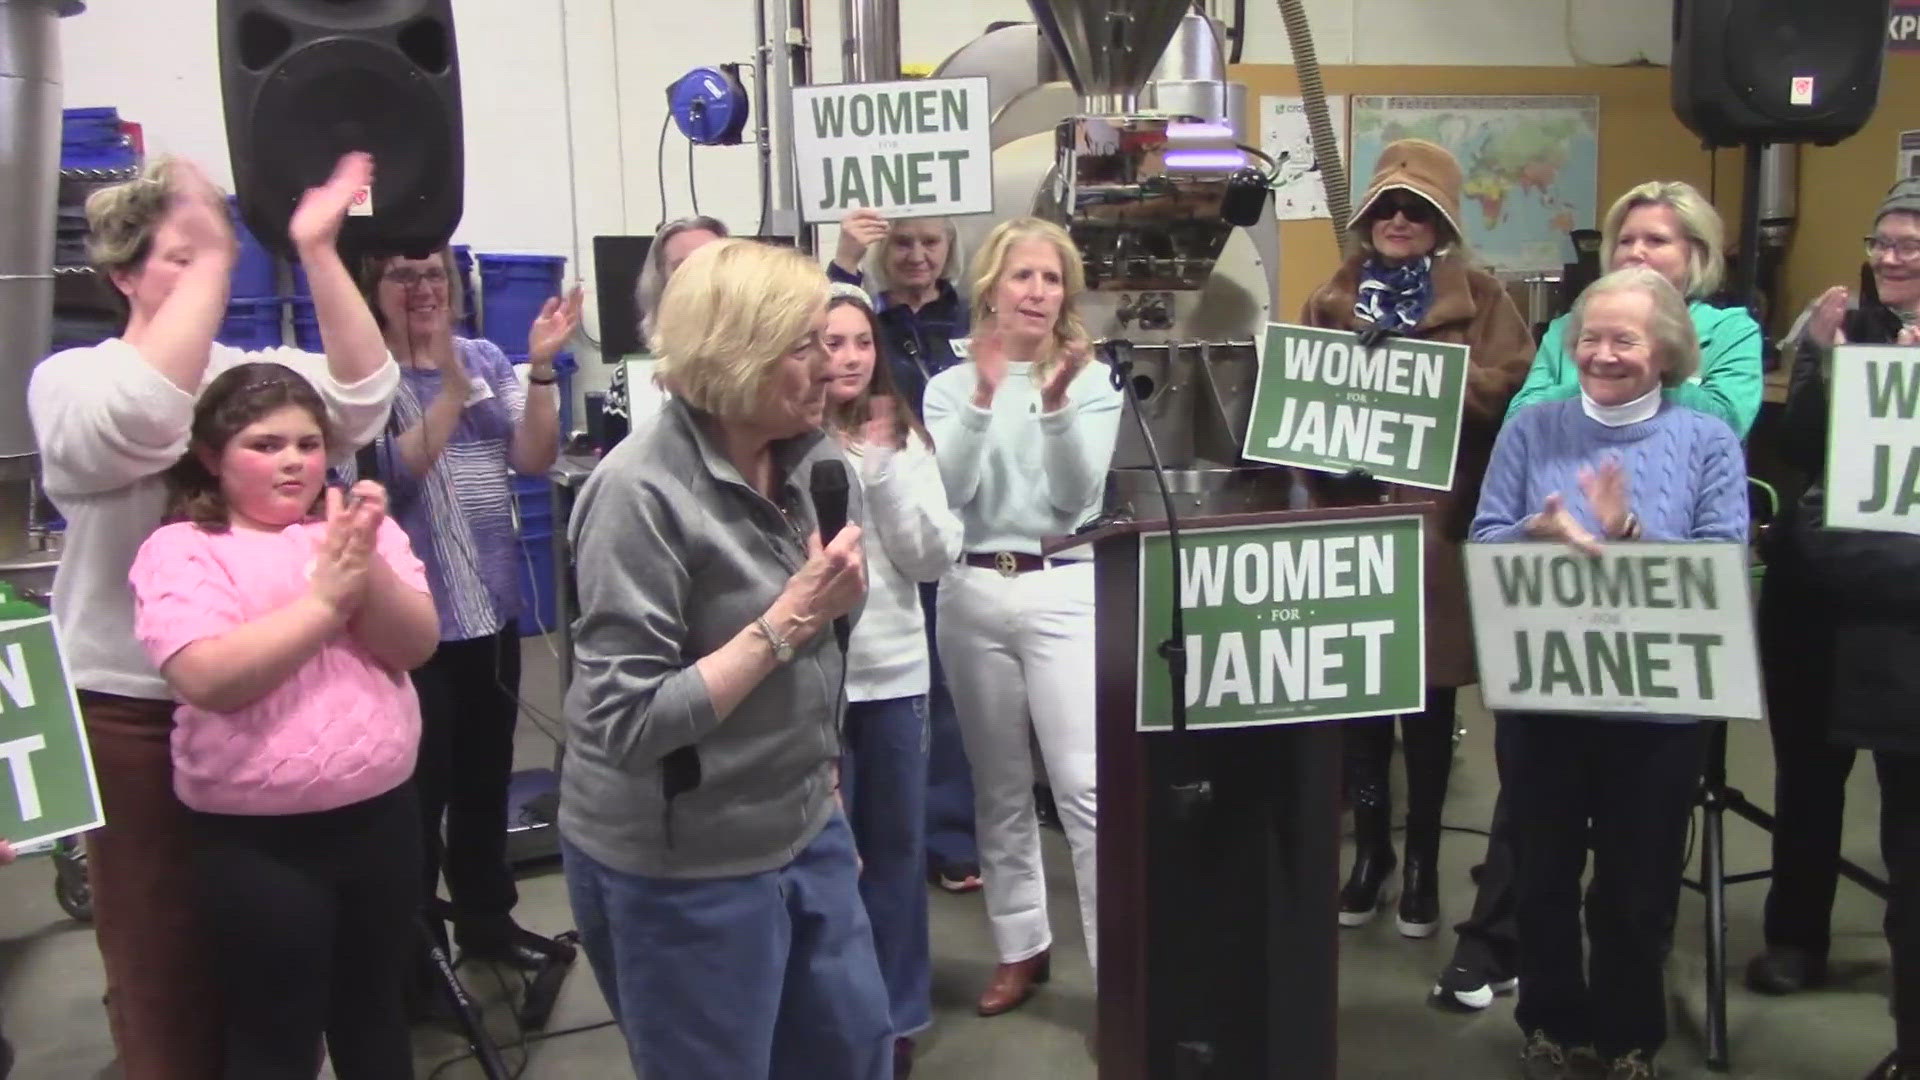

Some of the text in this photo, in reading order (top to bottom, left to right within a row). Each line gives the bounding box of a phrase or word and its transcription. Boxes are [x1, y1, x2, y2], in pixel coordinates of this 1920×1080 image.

[811, 88, 969, 139] WOMEN
[819, 150, 970, 209] JANET
[1284, 337, 1444, 399] WOMEN
[1346, 392, 1367, 403] FOR
[1266, 397, 1437, 470] JANET
[1180, 534, 1394, 609] WOMEN
[1493, 555, 1719, 610] WOMEN
[1271, 608, 1301, 622] FOR
[1184, 619, 1394, 709] JANET
[1509, 630, 1723, 700] JANET
